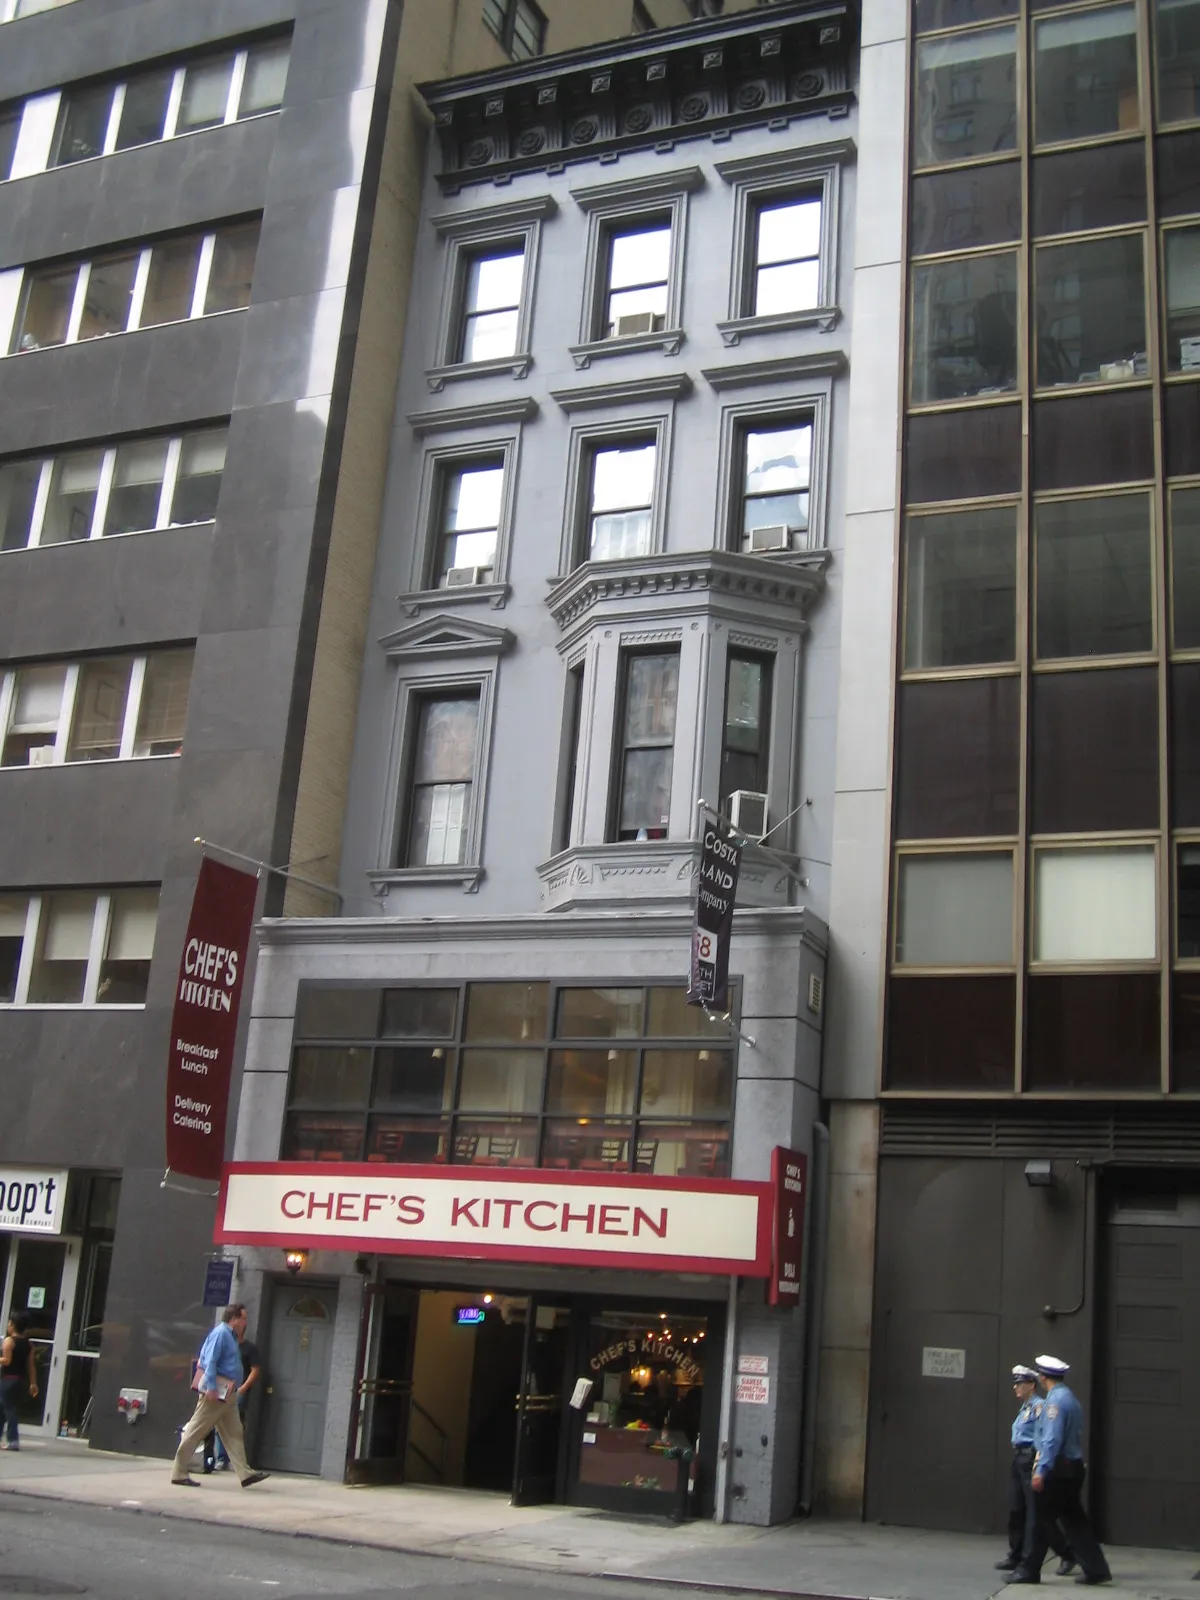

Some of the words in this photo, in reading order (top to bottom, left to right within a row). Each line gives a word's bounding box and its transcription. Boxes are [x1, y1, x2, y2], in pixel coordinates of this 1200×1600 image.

[705, 831, 738, 866] COSTA
[185, 938, 238, 986] CHEF'S
[180, 979, 232, 1013] KITCHEN
[176, 1039, 219, 1060] Breakfast
[181, 1057, 208, 1075] Lunch
[174, 1095, 212, 1116] Delivery
[173, 1112, 212, 1134] Catering
[280, 1190, 426, 1225] CHEF'S
[451, 1197, 668, 1238] KITCHEN
[590, 1339, 637, 1370] CHEF'S
[641, 1338, 701, 1377] KITCHEN
[737, 1384, 767, 1394] CONNECTION
